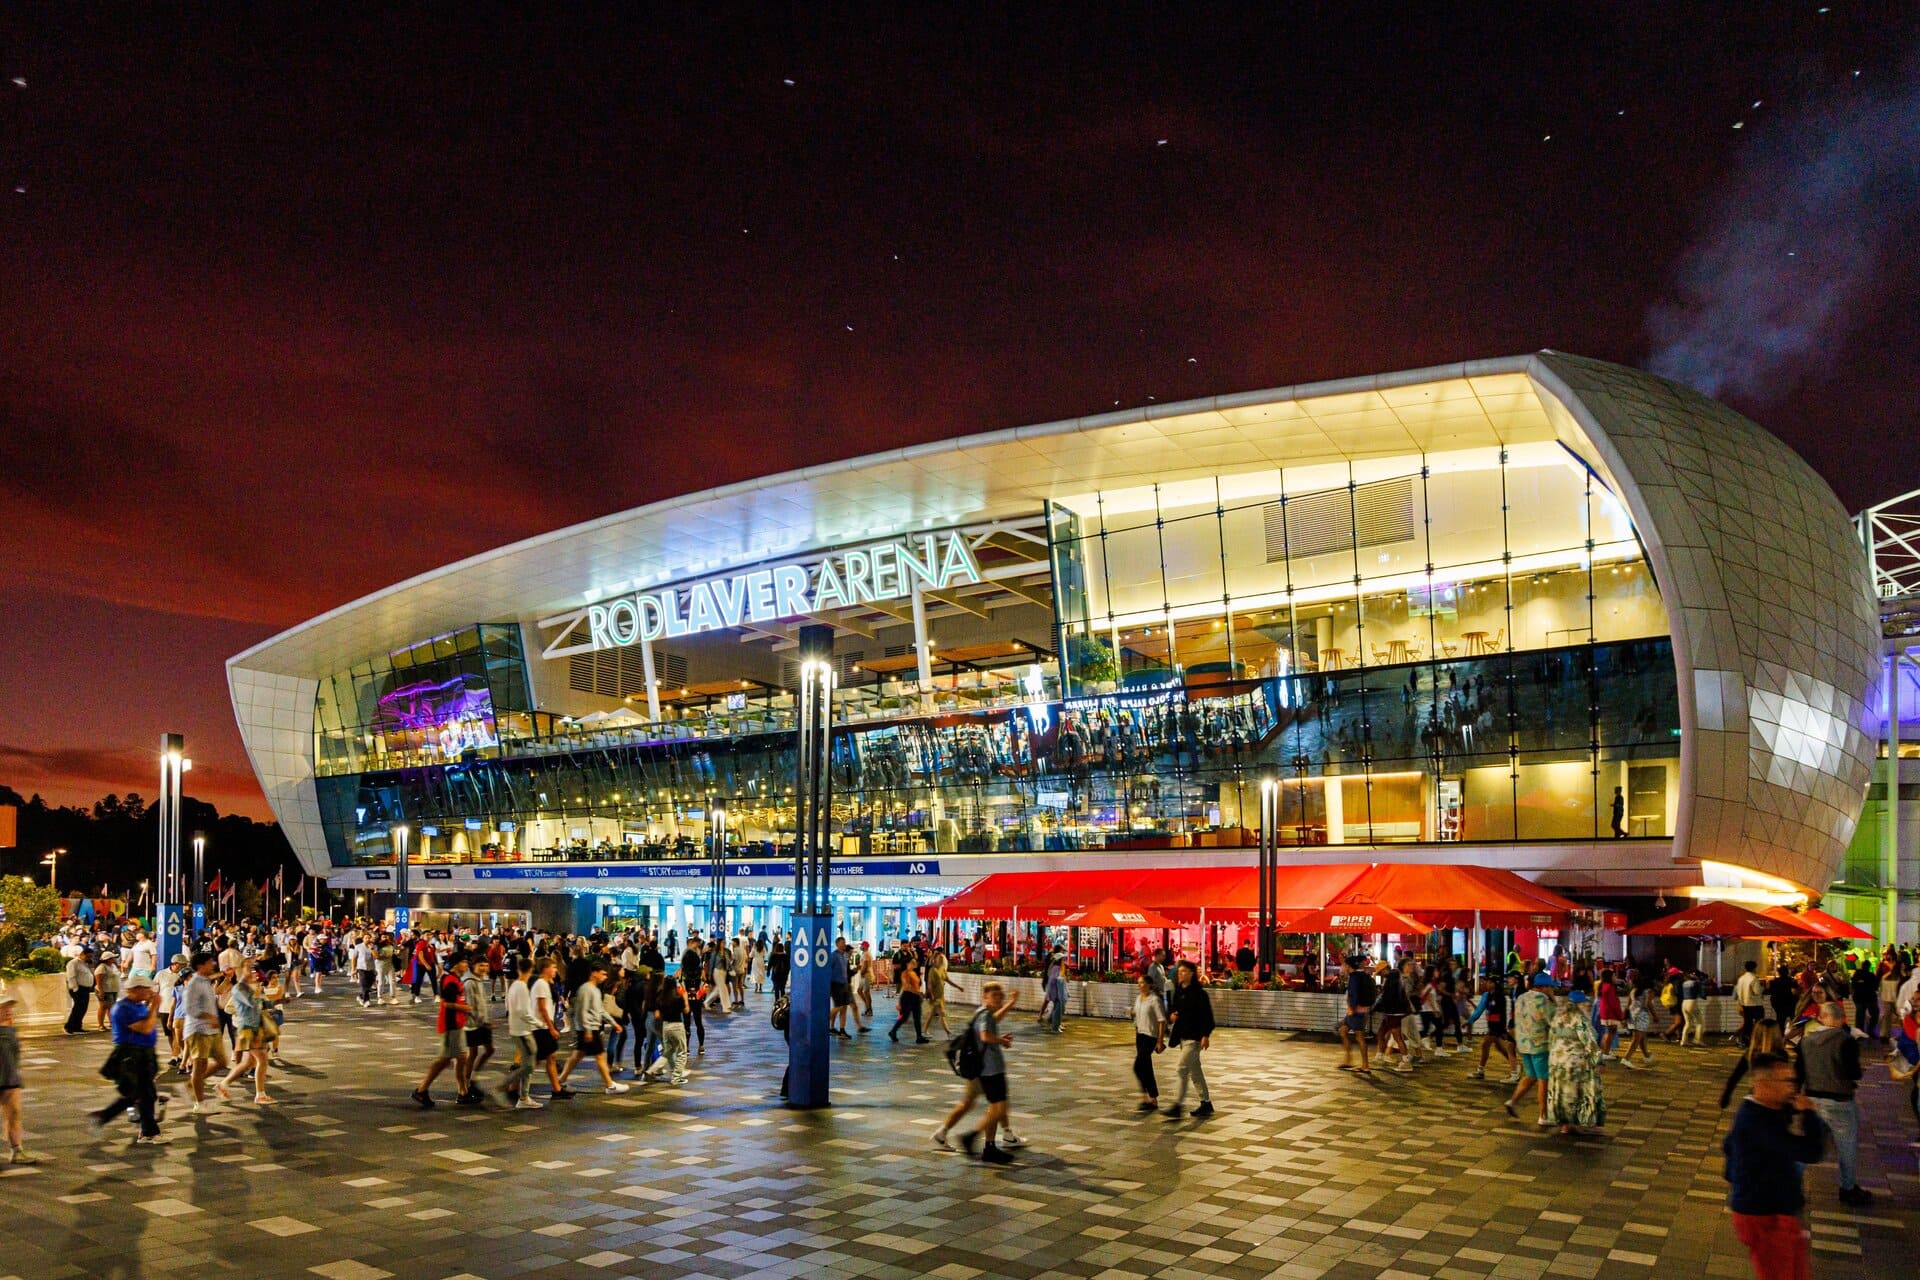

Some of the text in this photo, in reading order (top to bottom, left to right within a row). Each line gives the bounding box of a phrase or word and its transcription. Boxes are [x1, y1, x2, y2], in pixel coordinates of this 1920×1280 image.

[588, 529, 980, 650] ROD LAVER ARENA
[598, 868, 608, 876] AO
[648, 867, 671, 876] STORY
[687, 868, 701, 876] HERE
[737, 866, 751, 875] AO
[829, 867, 847, 875] TARTS
[847, 865, 864, 874] HERE
[909, 863, 926, 874] AO
[1340, 915, 1373, 923] PIPER
[794, 927, 809, 968] AO
[815, 928, 828, 968] AO
